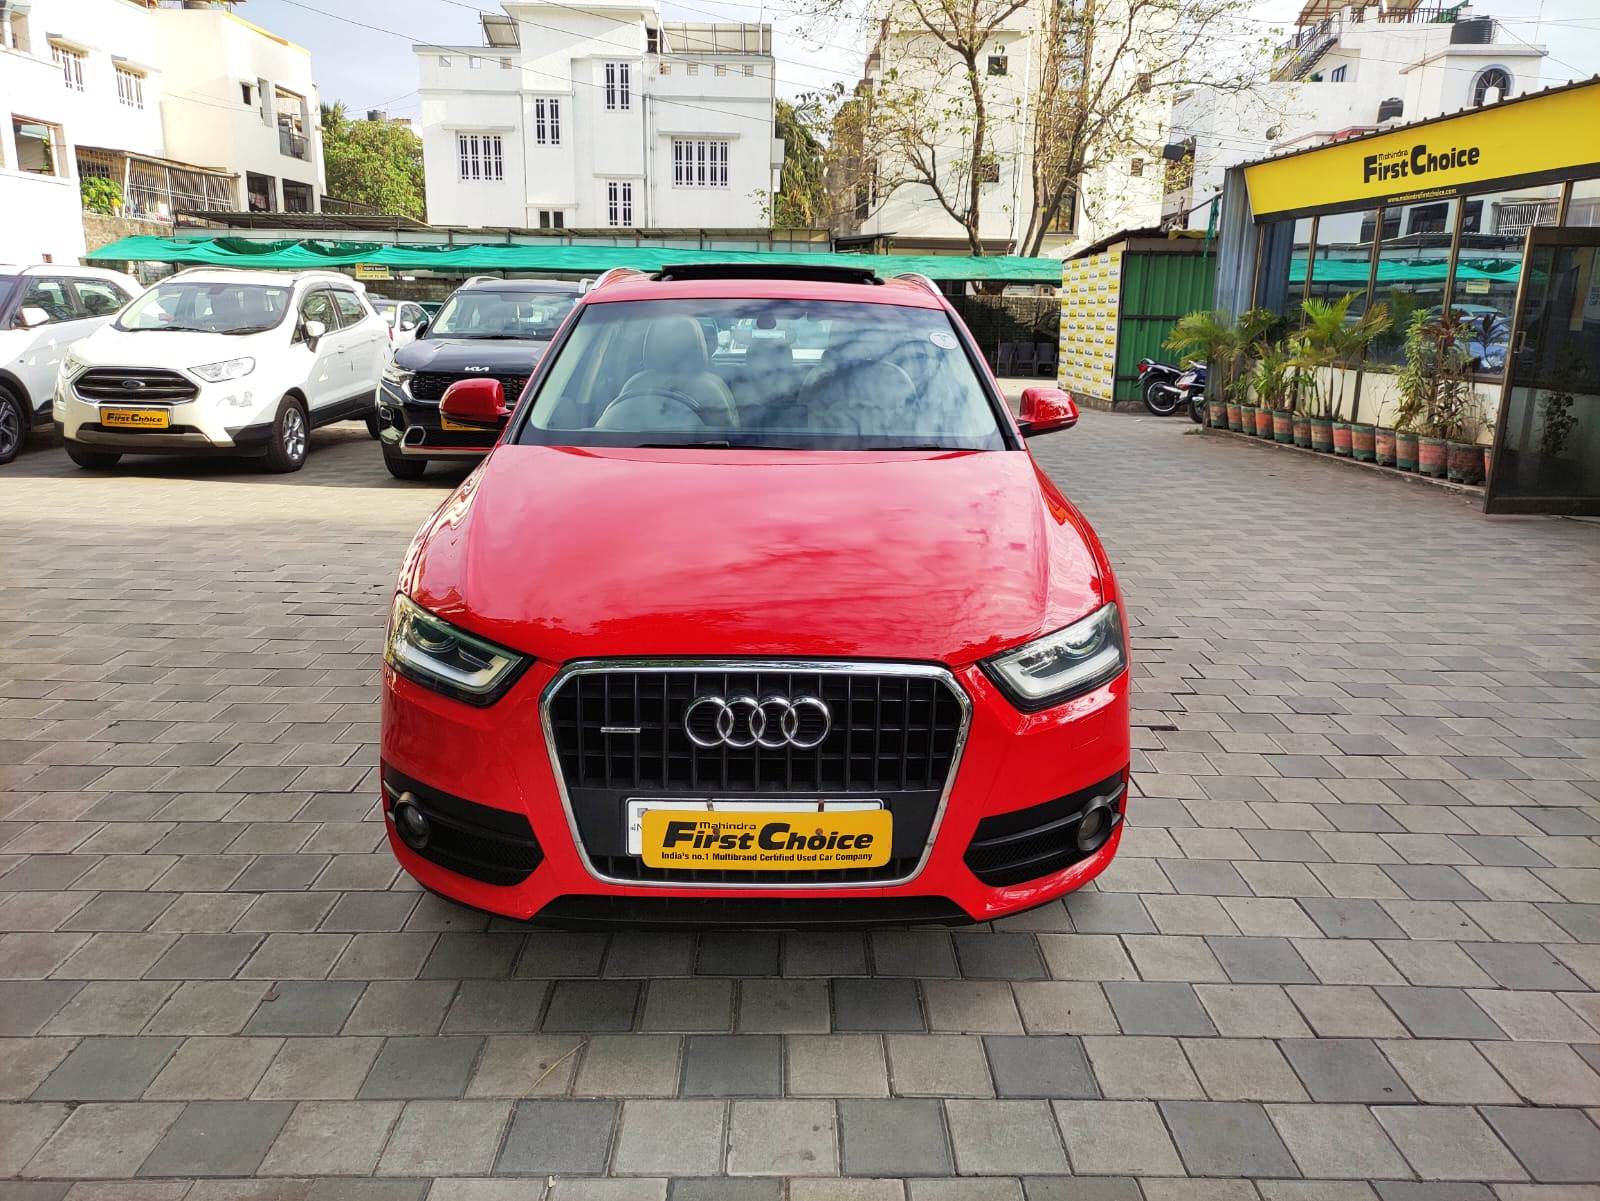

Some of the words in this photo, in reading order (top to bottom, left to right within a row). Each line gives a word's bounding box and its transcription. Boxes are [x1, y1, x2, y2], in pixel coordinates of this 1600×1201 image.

[1363, 154, 1408, 184] First
[1410, 144, 1480, 176] Choice
[107, 412, 130, 422] First
[131, 413, 163, 423] Choice
[662, 820, 755, 850] First
[758, 822, 874, 851] Choice
[661, 851, 690, 860] India's
[691, 853, 709, 861] no.1
[712, 853, 758, 861] Multibrand
[759, 853, 795, 862] Certified
[797, 854, 817, 862] Used
[819, 853, 833, 861] Car
[835, 852, 873, 862] Company
